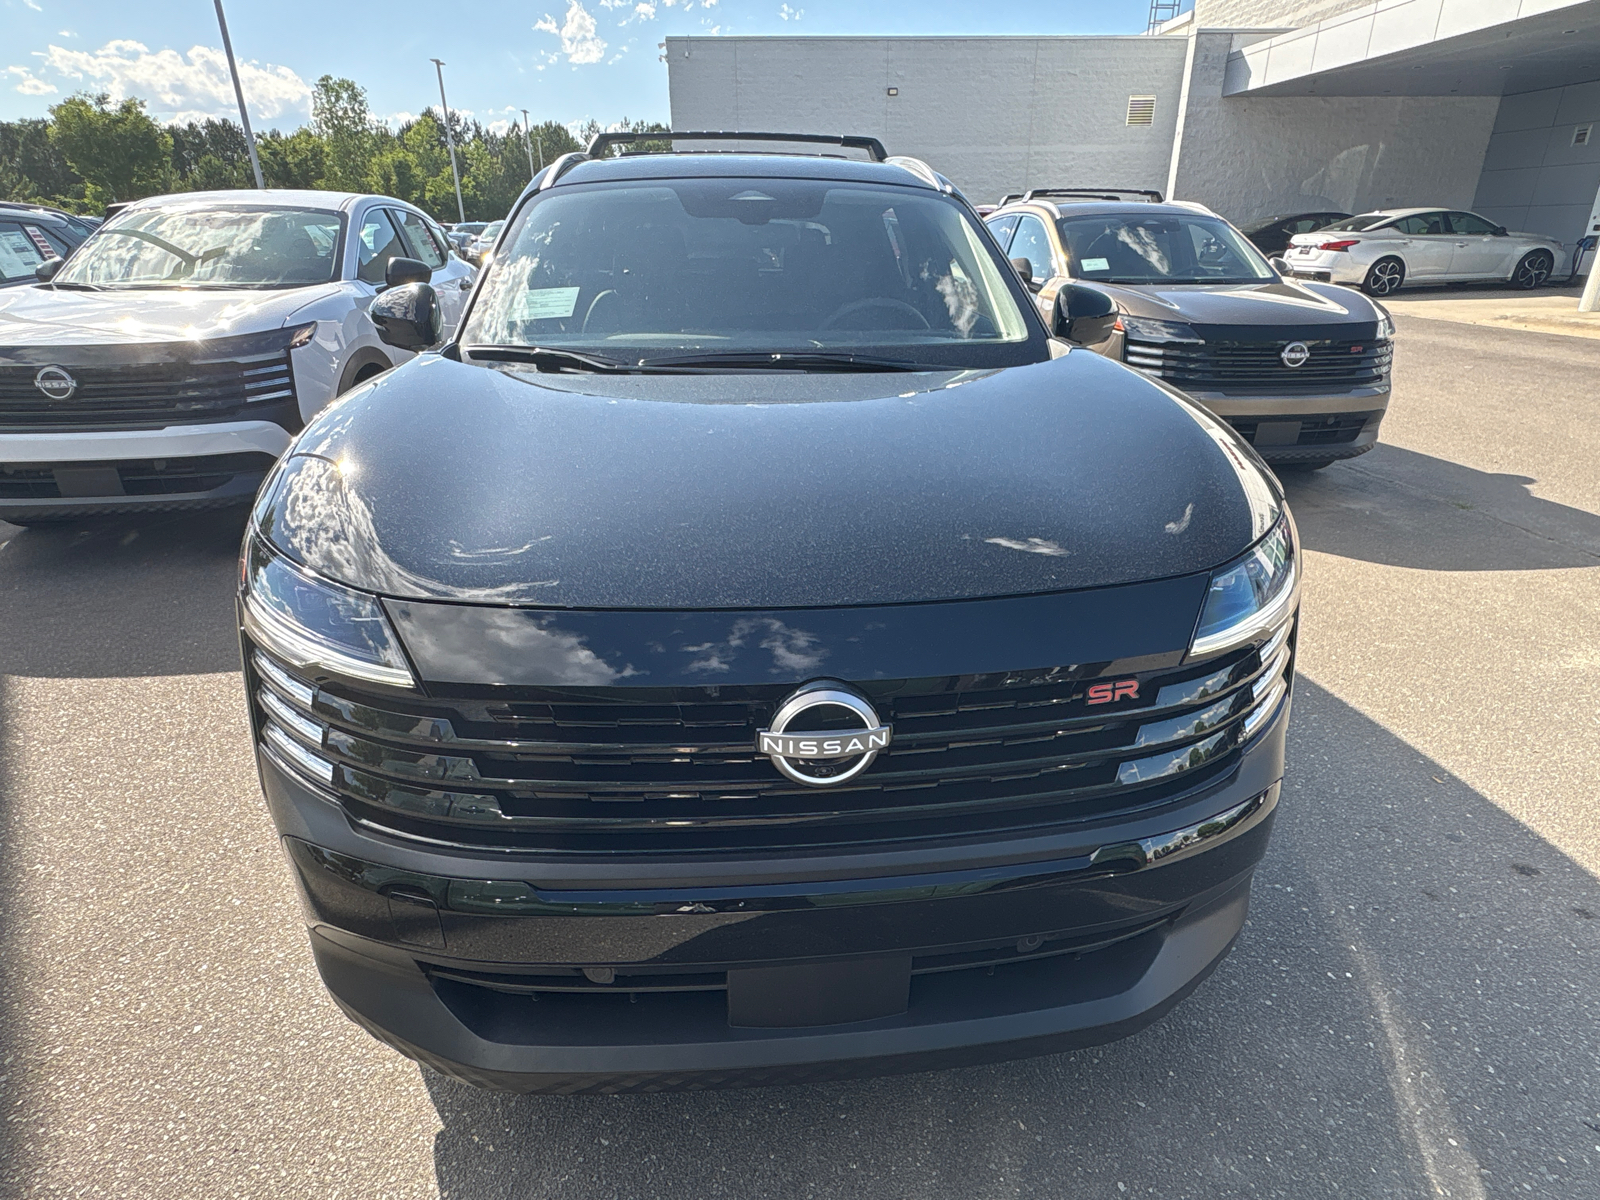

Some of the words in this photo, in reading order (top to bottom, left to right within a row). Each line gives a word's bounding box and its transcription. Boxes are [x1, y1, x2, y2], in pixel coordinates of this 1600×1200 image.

[34, 380, 77, 388] NISSAN
[1087, 680, 1140, 705] SR
[763, 731, 887, 755] NISSAN
